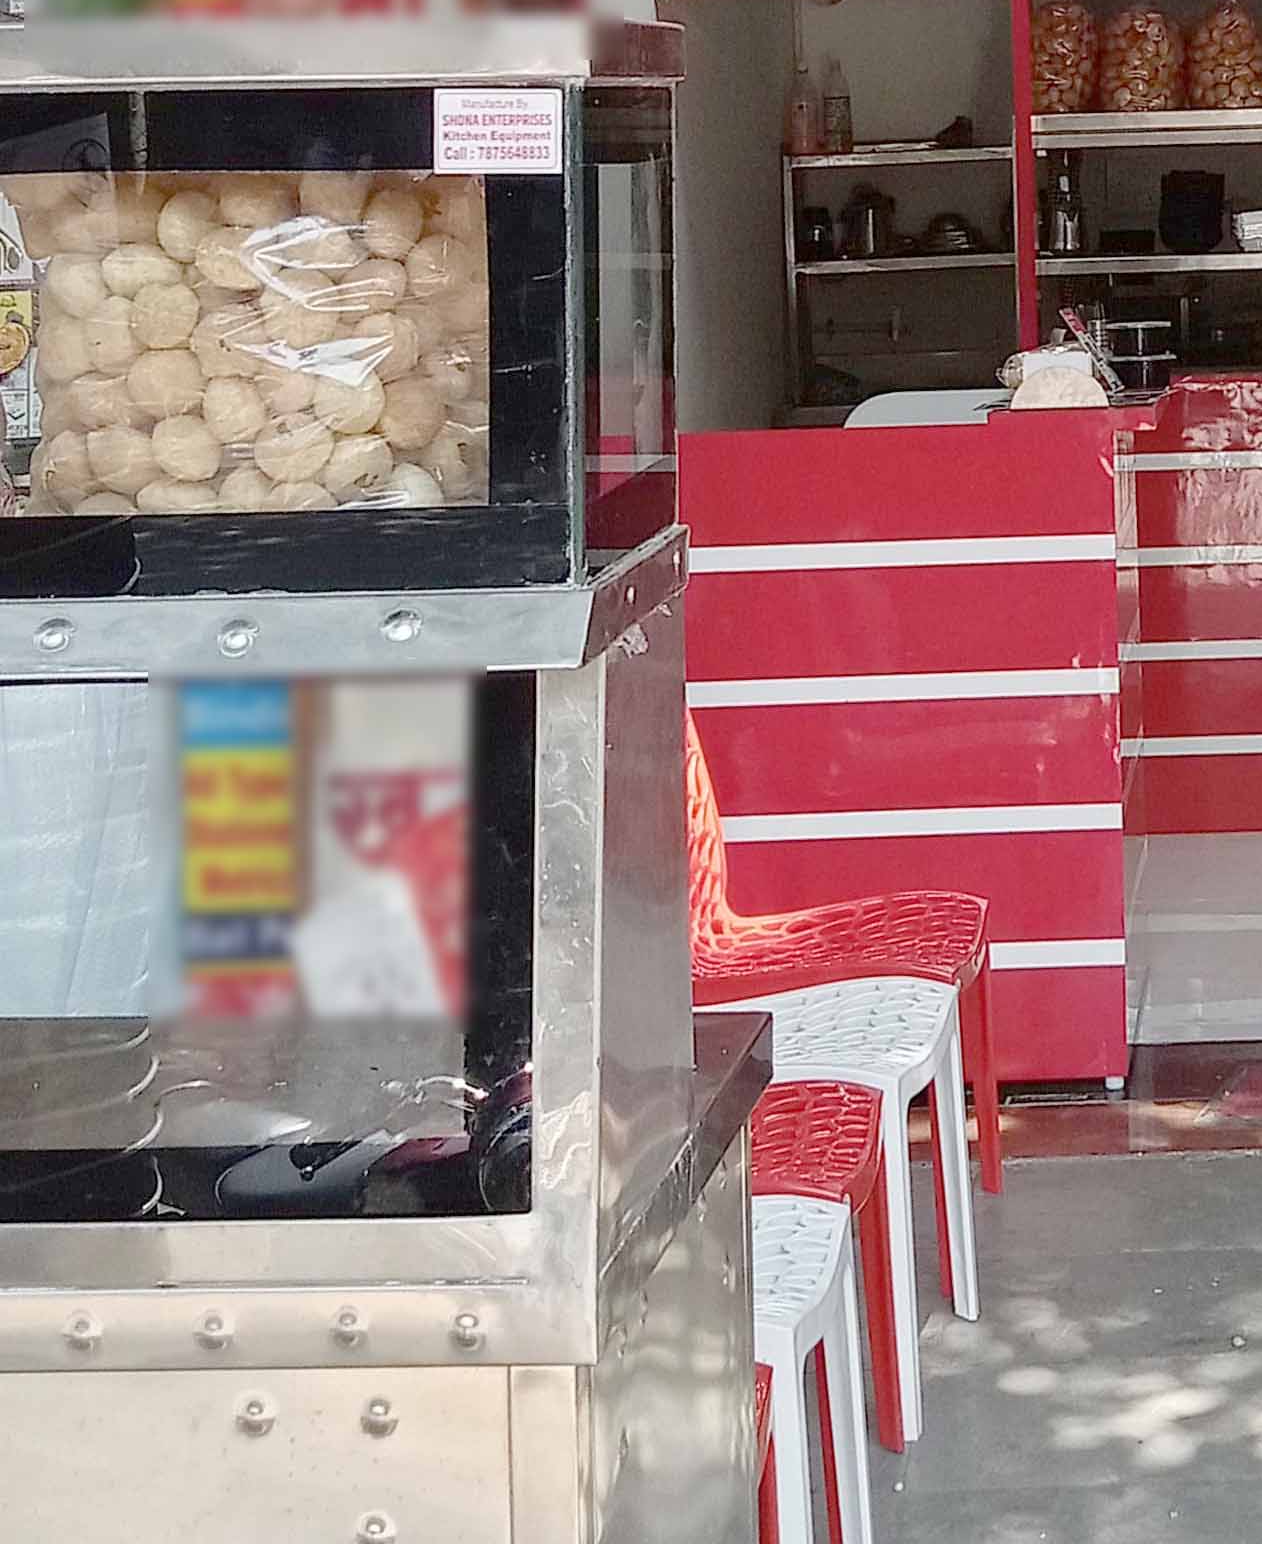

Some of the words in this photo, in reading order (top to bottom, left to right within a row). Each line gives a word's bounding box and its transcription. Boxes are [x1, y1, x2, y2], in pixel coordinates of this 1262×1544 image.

[482, 114, 552, 127] ENTERPRISES
[443, 130, 487, 142] Kitchen
[490, 130, 551, 143] Equipment
[444, 146, 468, 161] Call
